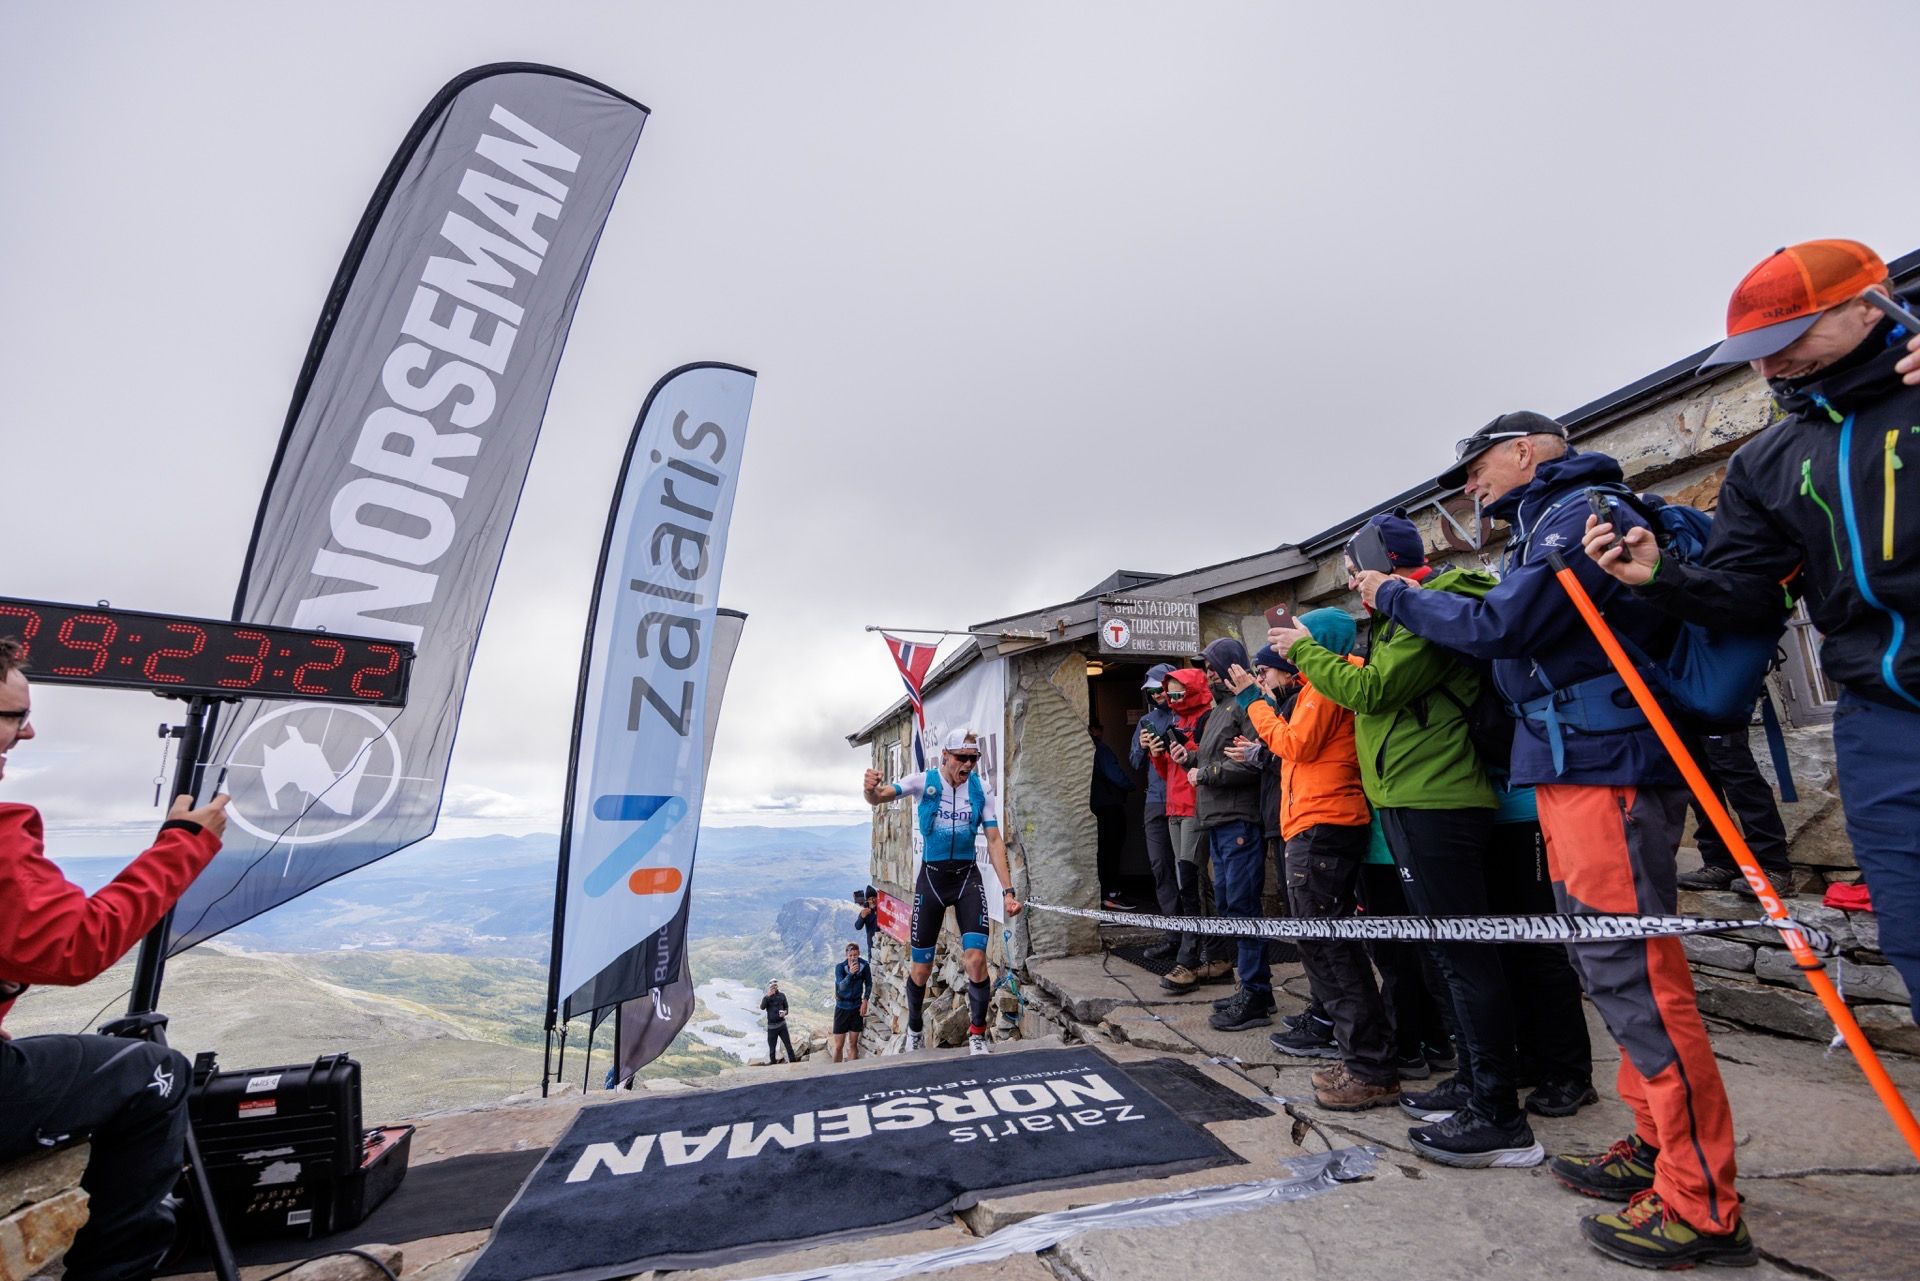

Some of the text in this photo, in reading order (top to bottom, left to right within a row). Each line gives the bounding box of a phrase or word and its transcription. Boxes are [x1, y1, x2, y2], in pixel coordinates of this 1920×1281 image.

[1774, 304, 1801, 317] Rab
[291, 103, 581, 650] NORSEMAN
[627, 409, 727, 737] zalaris
[1114, 598, 1196, 618] GAUSTATOPPEN
[1130, 619, 1197, 636] TURISTHYTTE
[1132, 639, 1197, 653] ENKEL SERVERING
[1152, 916, 1198, 932] NORSEMAN
[1200, 919, 1256, 935] NORSEMAN
[1257, 919, 1331, 938] NORSEMAN
[1334, 919, 1430, 939] NORSEMAN
[1434, 917, 1569, 940] NORSEMAN
[859, 1066, 1092, 1101] POWERED BY RENAULT
[565, 1074, 1125, 1183] NORSEMAN
[949, 1105, 1146, 1143] zalaris
